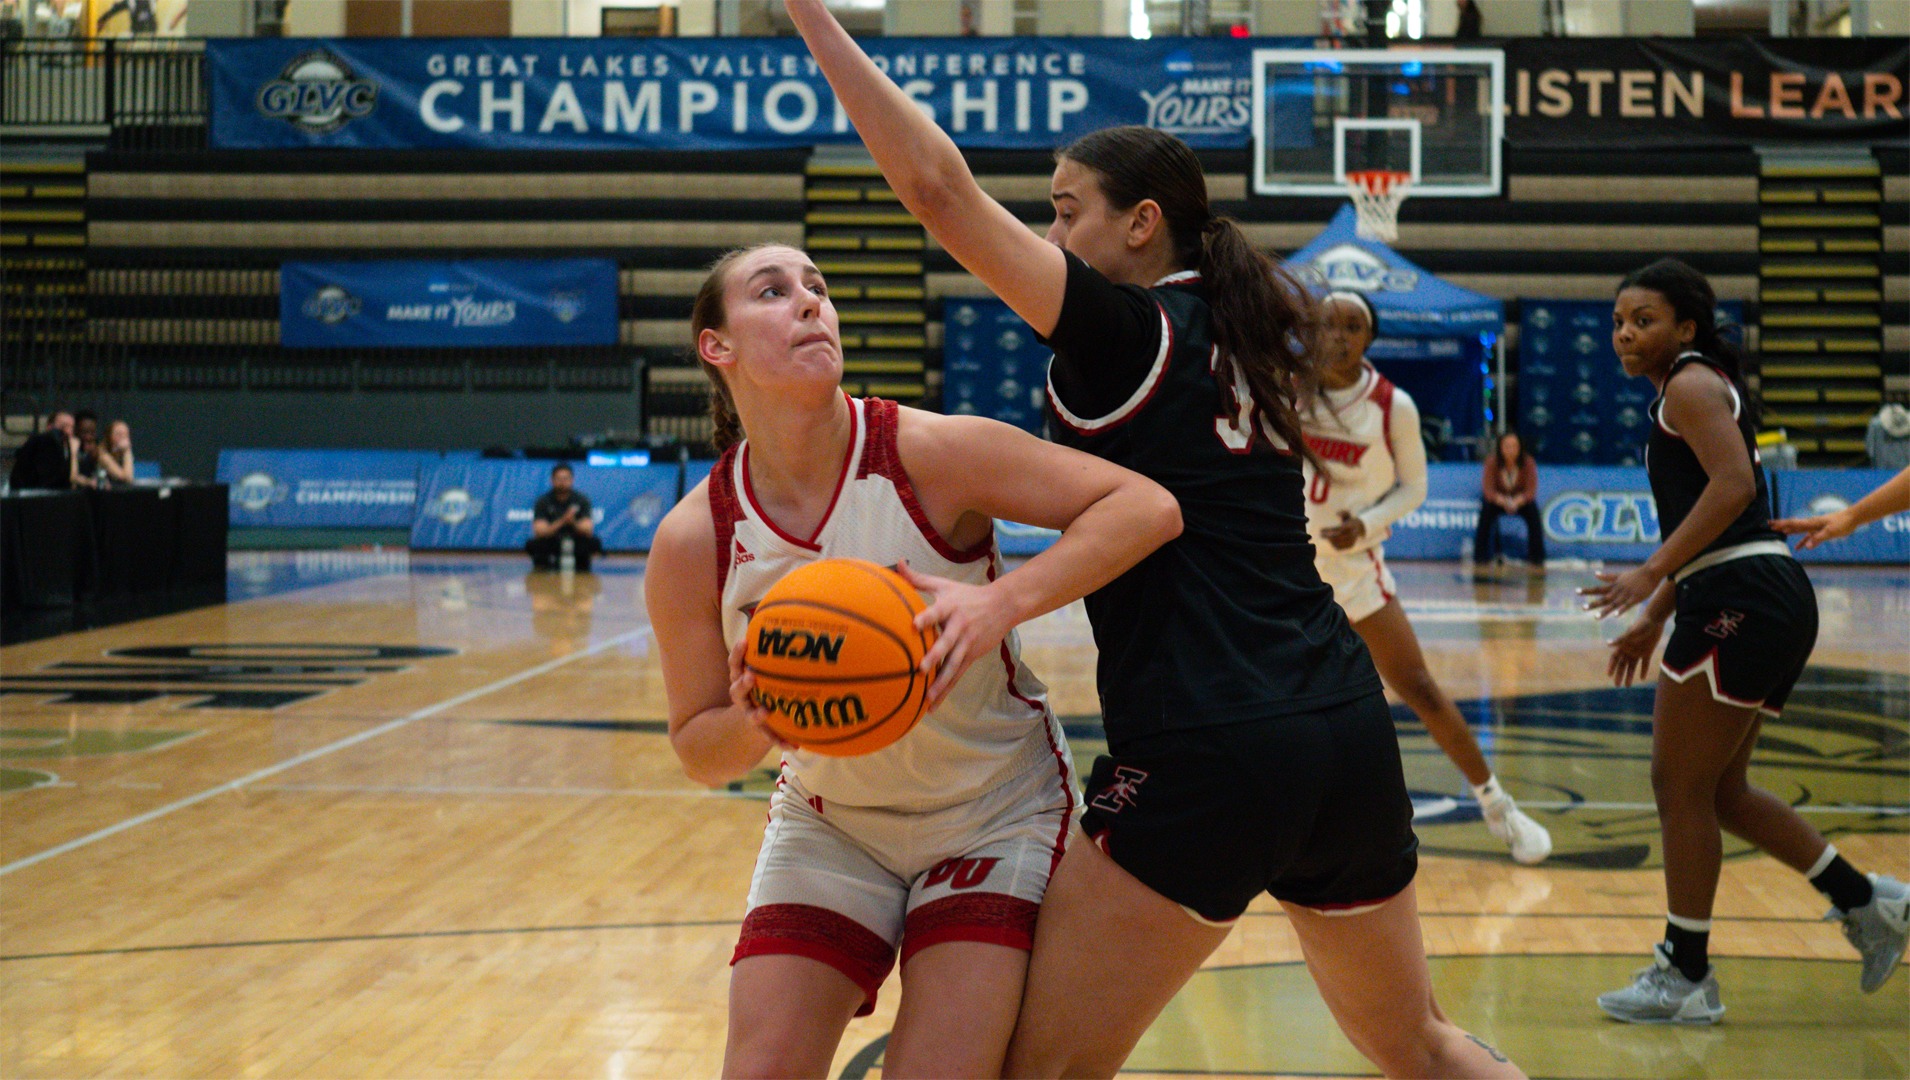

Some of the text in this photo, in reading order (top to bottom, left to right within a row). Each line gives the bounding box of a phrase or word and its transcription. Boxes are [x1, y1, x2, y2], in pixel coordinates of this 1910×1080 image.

[427, 54, 1086, 76] GREAT LAKES VALLEY ONFERENCE
[257, 79, 380, 117] GLVC
[1181, 78, 1250, 94] MAKE IT
[1478, 70, 1903, 119] LISTEN LEAR
[419, 79, 1089, 134] CHAMPIOSHIP
[387, 304, 432, 320] MAKE
[296, 490, 416, 505] CHAMPIONSHI
[1542, 490, 1662, 543] GLV
[758, 627, 846, 665] NCAA
